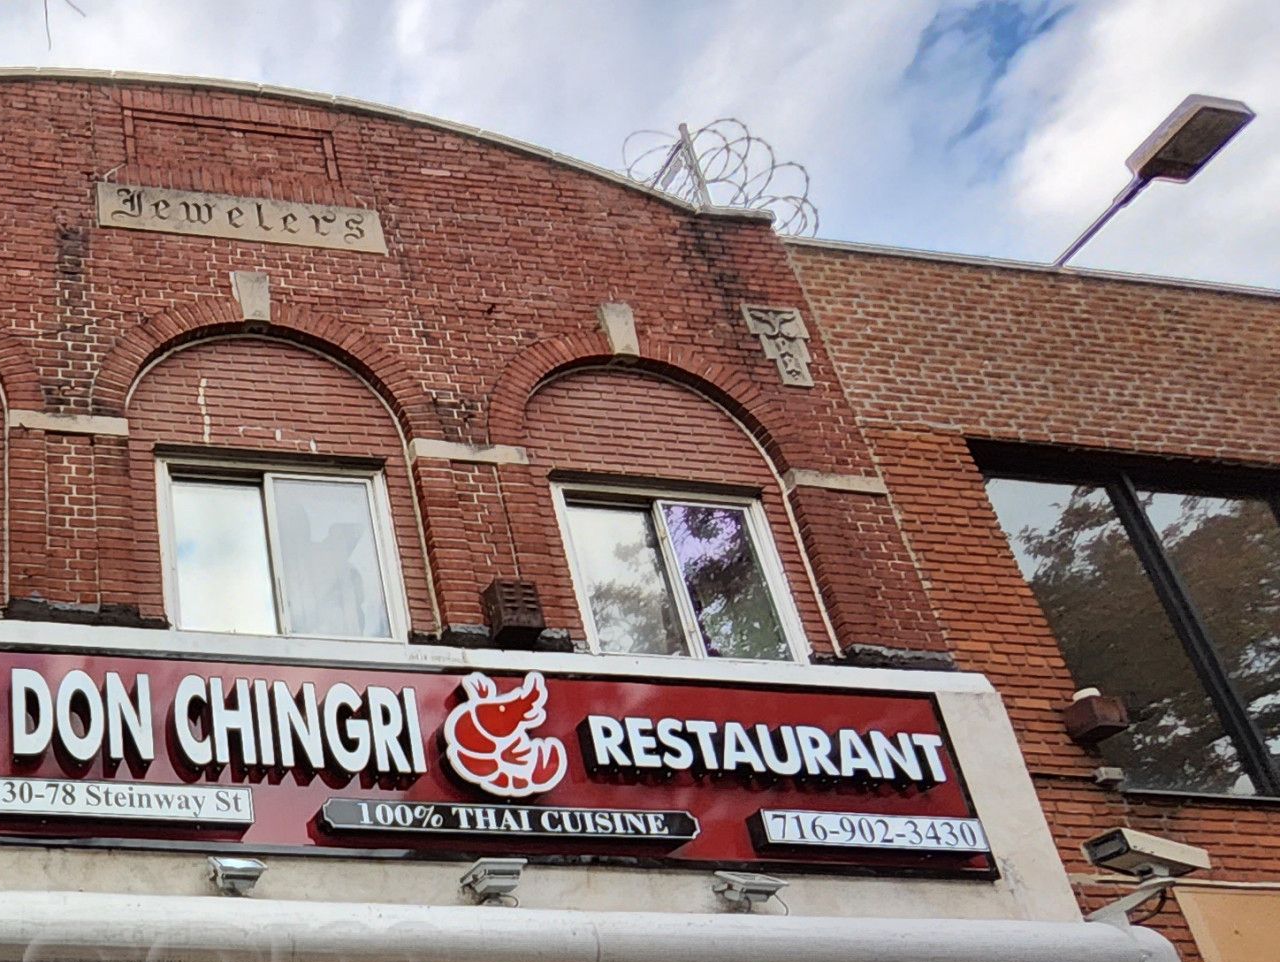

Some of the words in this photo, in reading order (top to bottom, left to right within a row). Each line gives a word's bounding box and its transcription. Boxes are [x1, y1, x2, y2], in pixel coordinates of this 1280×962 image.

[111, 187, 366, 244] Jewelers
[11, 668, 155, 761] DON
[174, 674, 427, 774] CHINGRI
[588, 715, 947, 784] RESTAURANT
[1, 782, 76, 806] 30-78
[85, 784, 206, 817] Steinway
[215, 793, 242, 813] St
[357, 801, 444, 828] 100%
[452, 806, 531, 832] THAI
[540, 810, 669, 836] CUISINE
[770, 813, 977, 849] 716-902-3430
